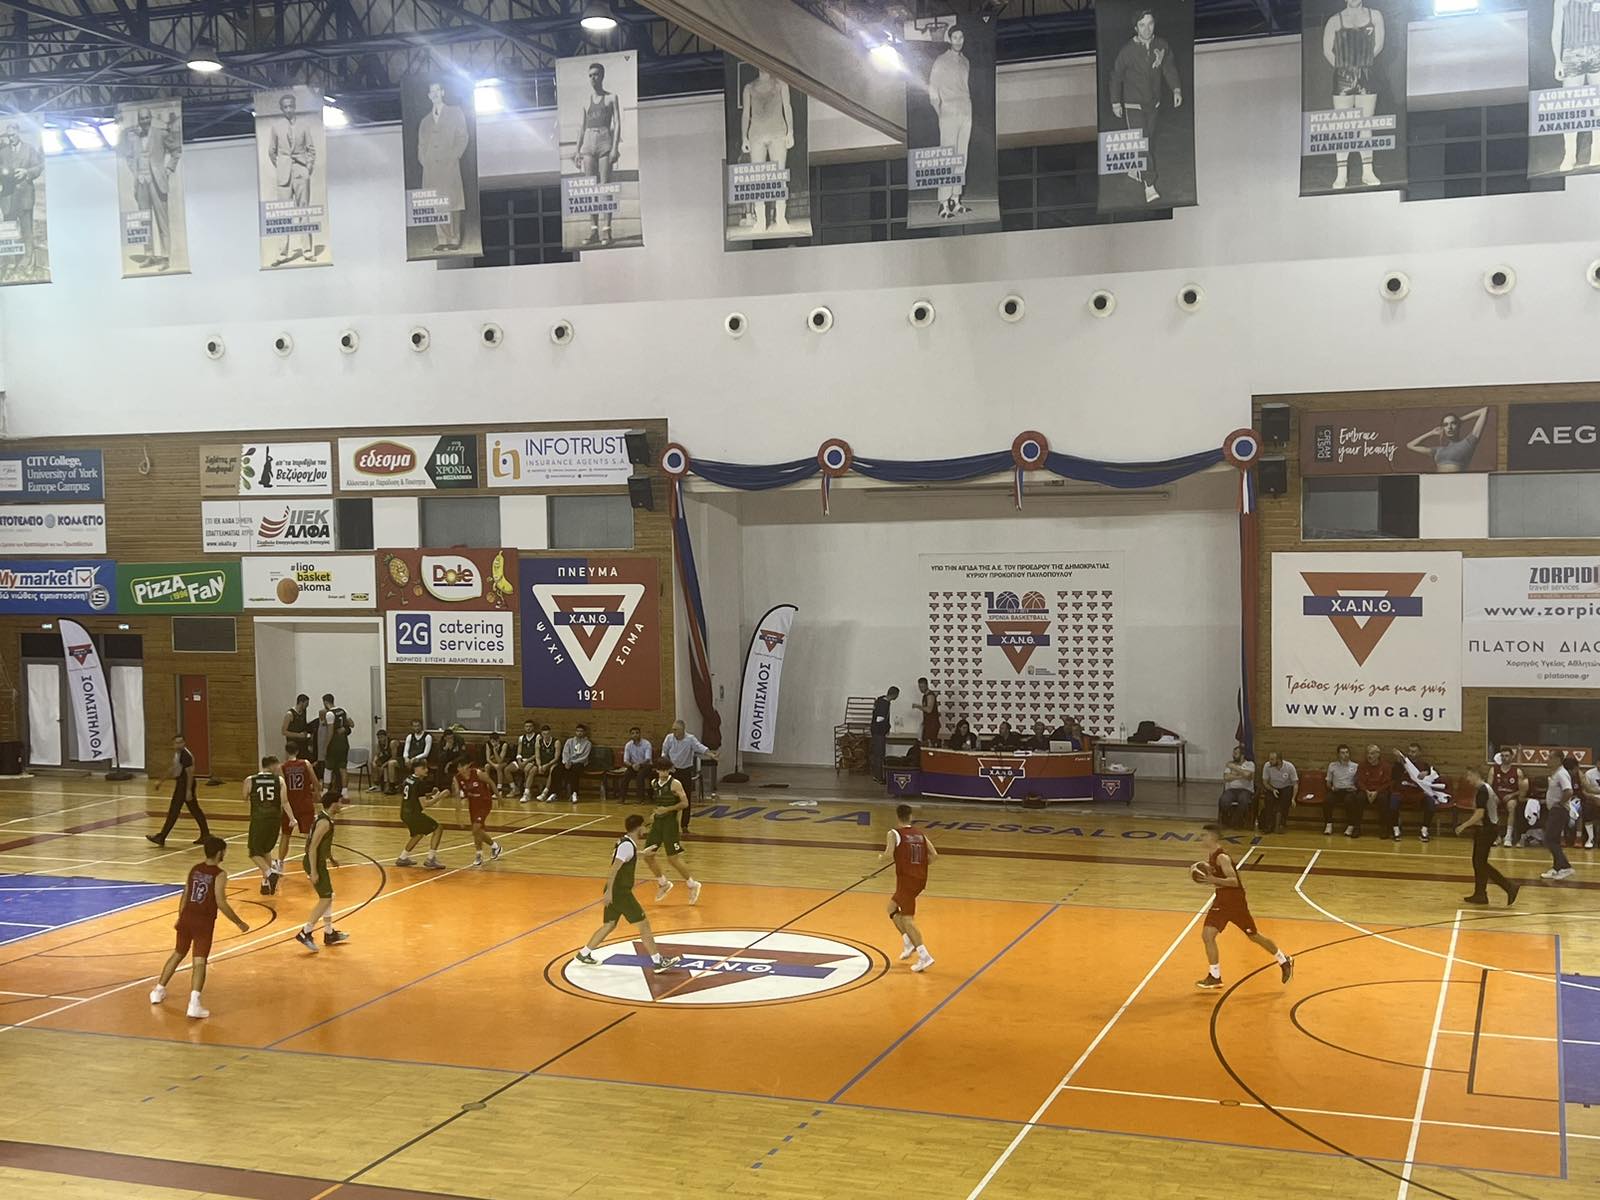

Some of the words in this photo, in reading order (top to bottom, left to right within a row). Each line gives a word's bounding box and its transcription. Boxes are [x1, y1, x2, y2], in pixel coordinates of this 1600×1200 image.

[1310, 110, 1360, 123] ΜΙΧΑΛΗΣ
[1538, 109, 1587, 122] DIONISIS
[1310, 117, 1393, 132] ΓΙΑΝΝΟΥΖΑΚΟΣ
[1538, 119, 1600, 132] ANANIADIS
[1106, 131, 1140, 142] ΛΑΚΗΣ
[1310, 131, 1355, 143] MIHALIS
[1310, 138, 1392, 152] GIANNOUZAKOS
[915, 147, 953, 159] ΓΙΩΡΓΟΣ
[1106, 152, 1136, 162] LAKIS
[915, 157, 963, 168] ΤΡΟΝΤΖΟΣ
[1106, 160, 1143, 171] TSAVAS
[915, 167, 952, 178] GIORGOS
[734, 181, 782, 192] THEODOROS
[915, 175, 962, 187] TRONTZOS
[734, 191, 786, 201] RODOPOULOS
[1338, 427, 1381, 445] Embrace
[1527, 425, 1598, 445] AEG
[525, 436, 625, 456] INFOTRUST
[1337, 445, 1363, 463] your
[1363, 441, 1399, 462] beauty
[26, 456, 49, 466] CITY
[435, 453, 459, 466] 100
[27, 469, 67, 480] University
[68, 468, 77, 479] of
[79, 468, 98, 478] York
[435, 465, 472, 475] ΧΡΟΝΙΑ
[28, 482, 56, 494] Europe
[57, 481, 90, 493] Campus
[284, 525, 331, 538] ΑΛΦΑ
[20, 570, 73, 586] market
[297, 572, 331, 582] basket
[433, 564, 473, 582] Dole
[558, 567, 618, 577] ΠΝΕΥΜΑ
[298, 583, 332, 592] akoma
[1331, 599, 1396, 613] Χ.Α.Ν.Θ.
[569, 614, 610, 624] Χ.Α.Ν.Θ.
[398, 622, 429, 646] 2G
[438, 619, 504, 638] catering
[439, 636, 505, 652] services
[536, 621, 564, 665] ΨΥΧΗ
[615, 622, 645, 665] ΣΩΜΑ
[1286, 675, 1330, 694] Τρόπος
[1369, 683, 1391, 697] για
[1394, 683, 1418, 695] μια
[577, 689, 605, 701] 1921
[750, 662, 771, 750] ΑΘΛΗΤΙΣΜΟΣ
[1286, 704, 1447, 721] www.ymca.gr
[288, 773, 305, 791] 12
[256, 786, 275, 802] 15
[690, 805, 872, 826] MCA
[673, 960, 776, 974] .Α.Ν.Θ.
